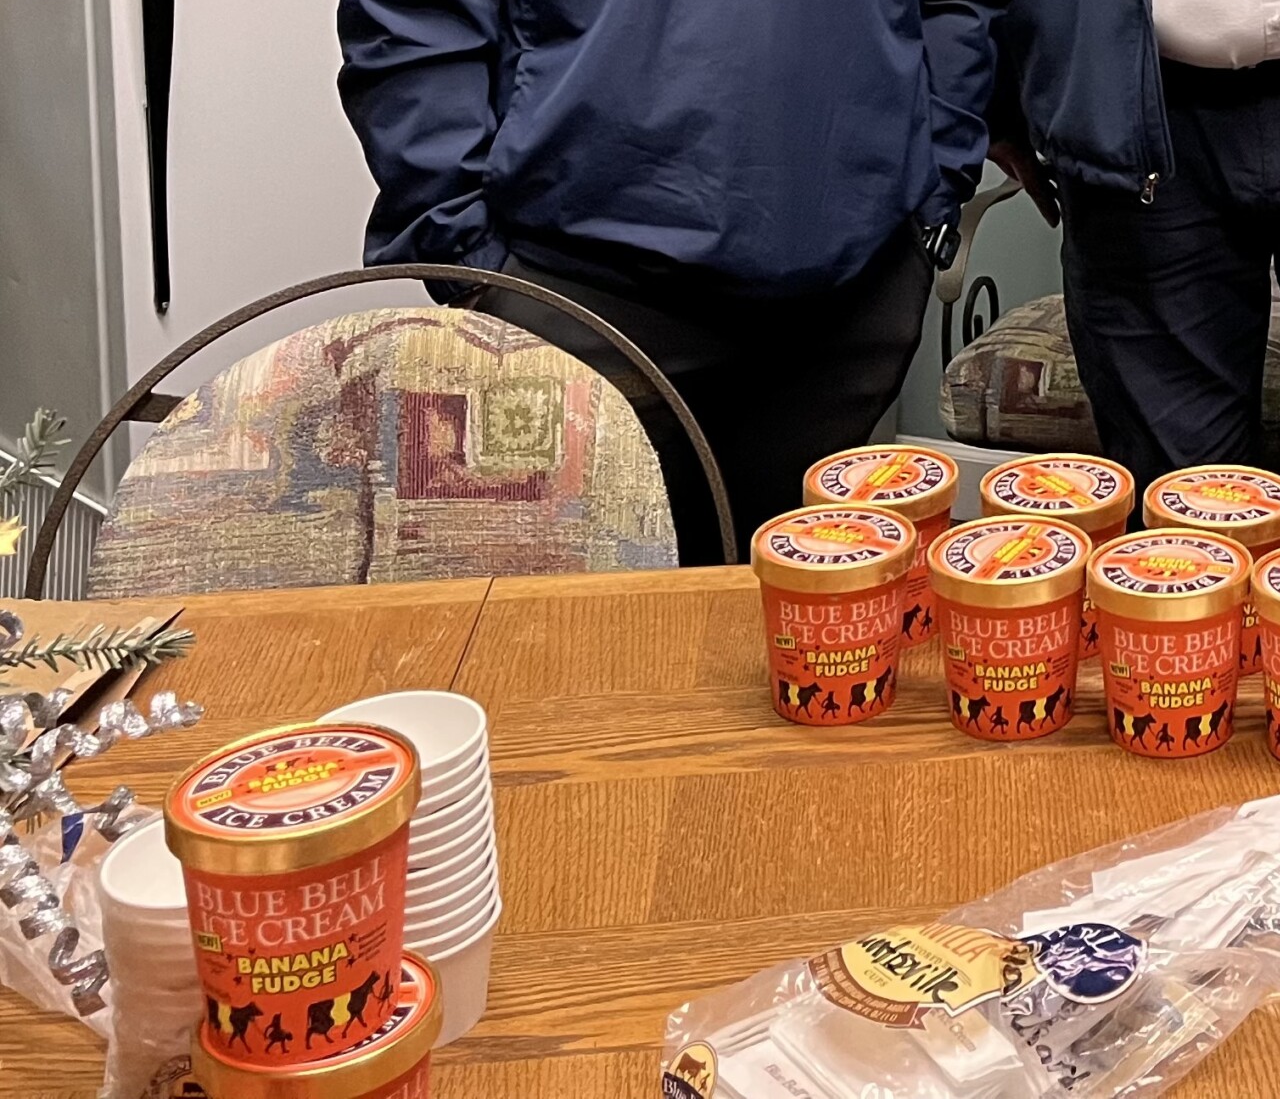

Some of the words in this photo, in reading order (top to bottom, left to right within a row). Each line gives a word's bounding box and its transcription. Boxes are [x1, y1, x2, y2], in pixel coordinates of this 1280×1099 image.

[1185, 509, 1261, 522] CREAM
[793, 550, 872, 564] CREAM
[779, 599, 843, 625] BLUE
[851, 589, 900, 622] BELL
[950, 610, 1010, 639] BLUE
[1017, 606, 1072, 638] BELL
[821, 608, 898, 644] CREAM
[1113, 626, 1177, 655] BLUE
[1184, 621, 1236, 652] BELL
[806, 644, 877, 664] BANANA
[988, 625, 1070, 659] CREAM
[815, 660, 870, 677] FUDGE
[975, 662, 1046, 678] BANANA
[1155, 641, 1234, 676] CREAM
[983, 676, 1038, 692] FUDGE
[1140, 677, 1212, 695] BANANA
[1150, 692, 1204, 709] FUDGE
[202, 744, 279, 787] BLUE
[294, 735, 370, 752] BELL
[248, 761, 340, 790] BANANA
[261, 770, 331, 793] FUDGE
[212, 808, 269, 828] ICE
[282, 773, 390, 826] CREAM
[196, 880, 288, 918] BLUE
[300, 856, 387, 912] BELL
[201, 911, 249, 946] ICE
[257, 881, 387, 947] CREAM
[237, 941, 349, 975] BANANA
[251, 964, 337, 995] FUDGE
[863, 969, 889, 989] CUPS
